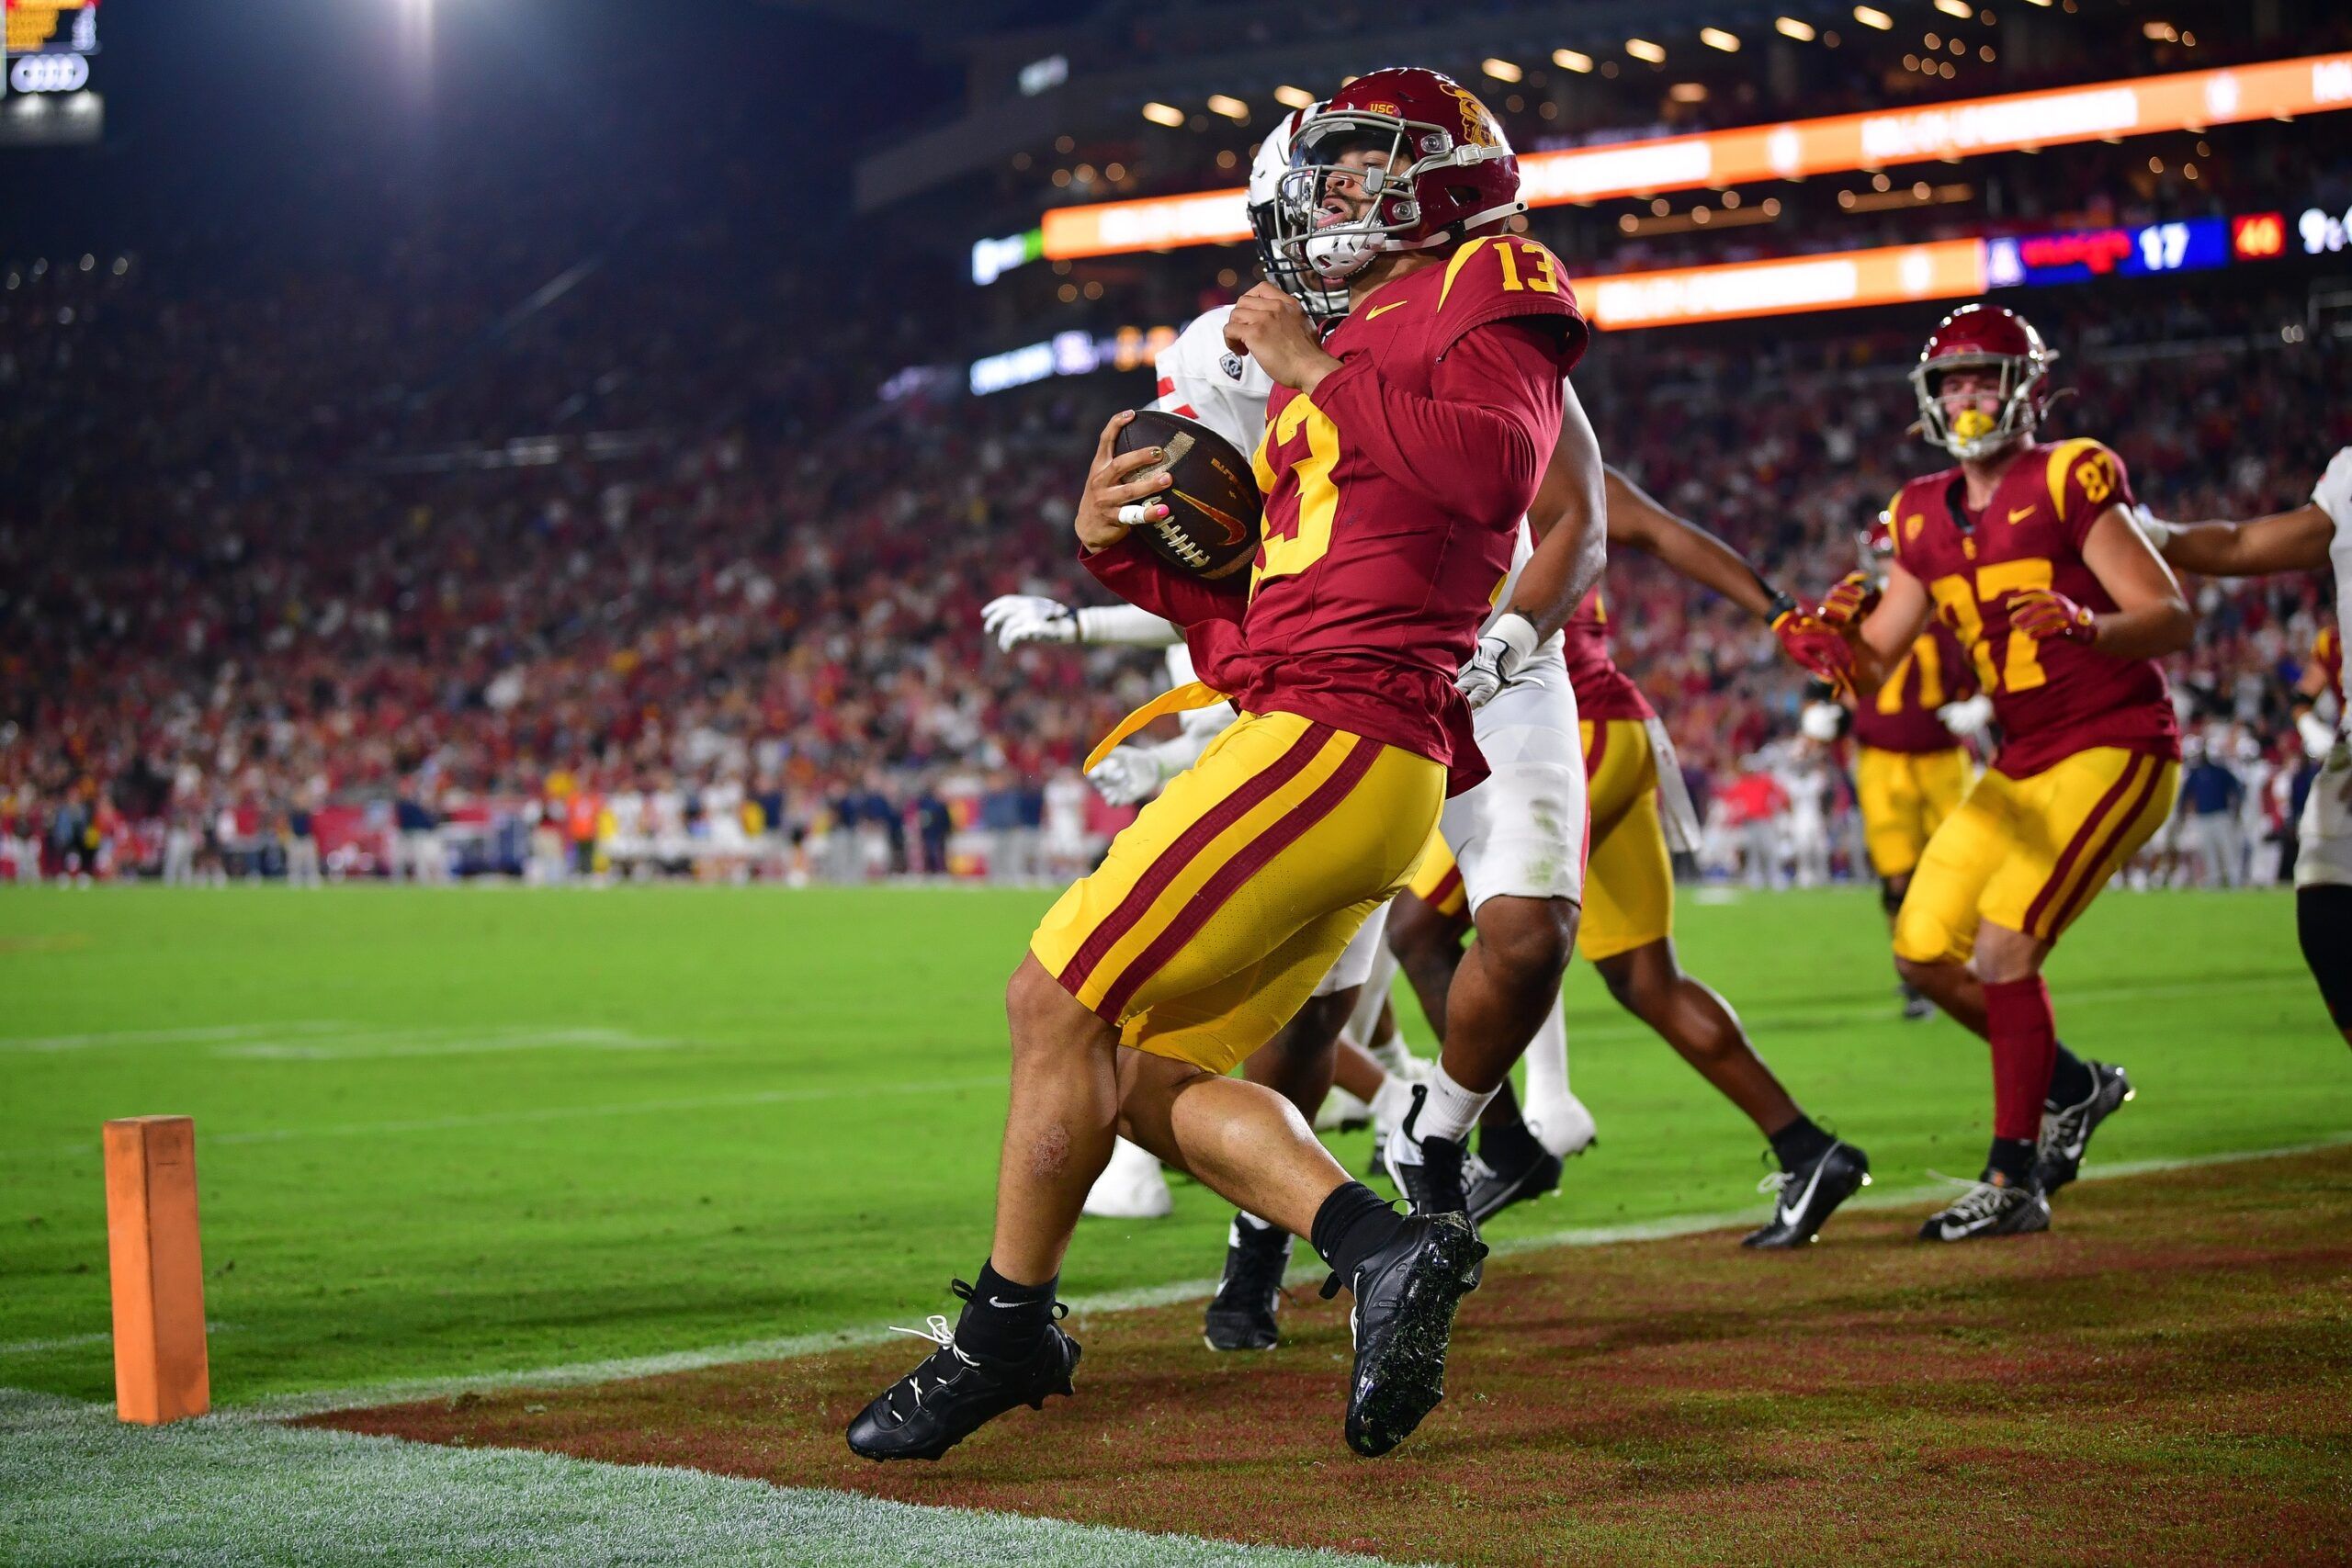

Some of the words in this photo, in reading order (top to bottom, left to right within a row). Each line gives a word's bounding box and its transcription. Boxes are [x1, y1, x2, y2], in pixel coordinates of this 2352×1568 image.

[1370, 103, 1395, 115] USC
[1492, 242, 1559, 294] 13
[2139, 222, 2190, 271] 17
[2075, 451, 2116, 504] 87
[1931, 555, 2053, 695] 87
